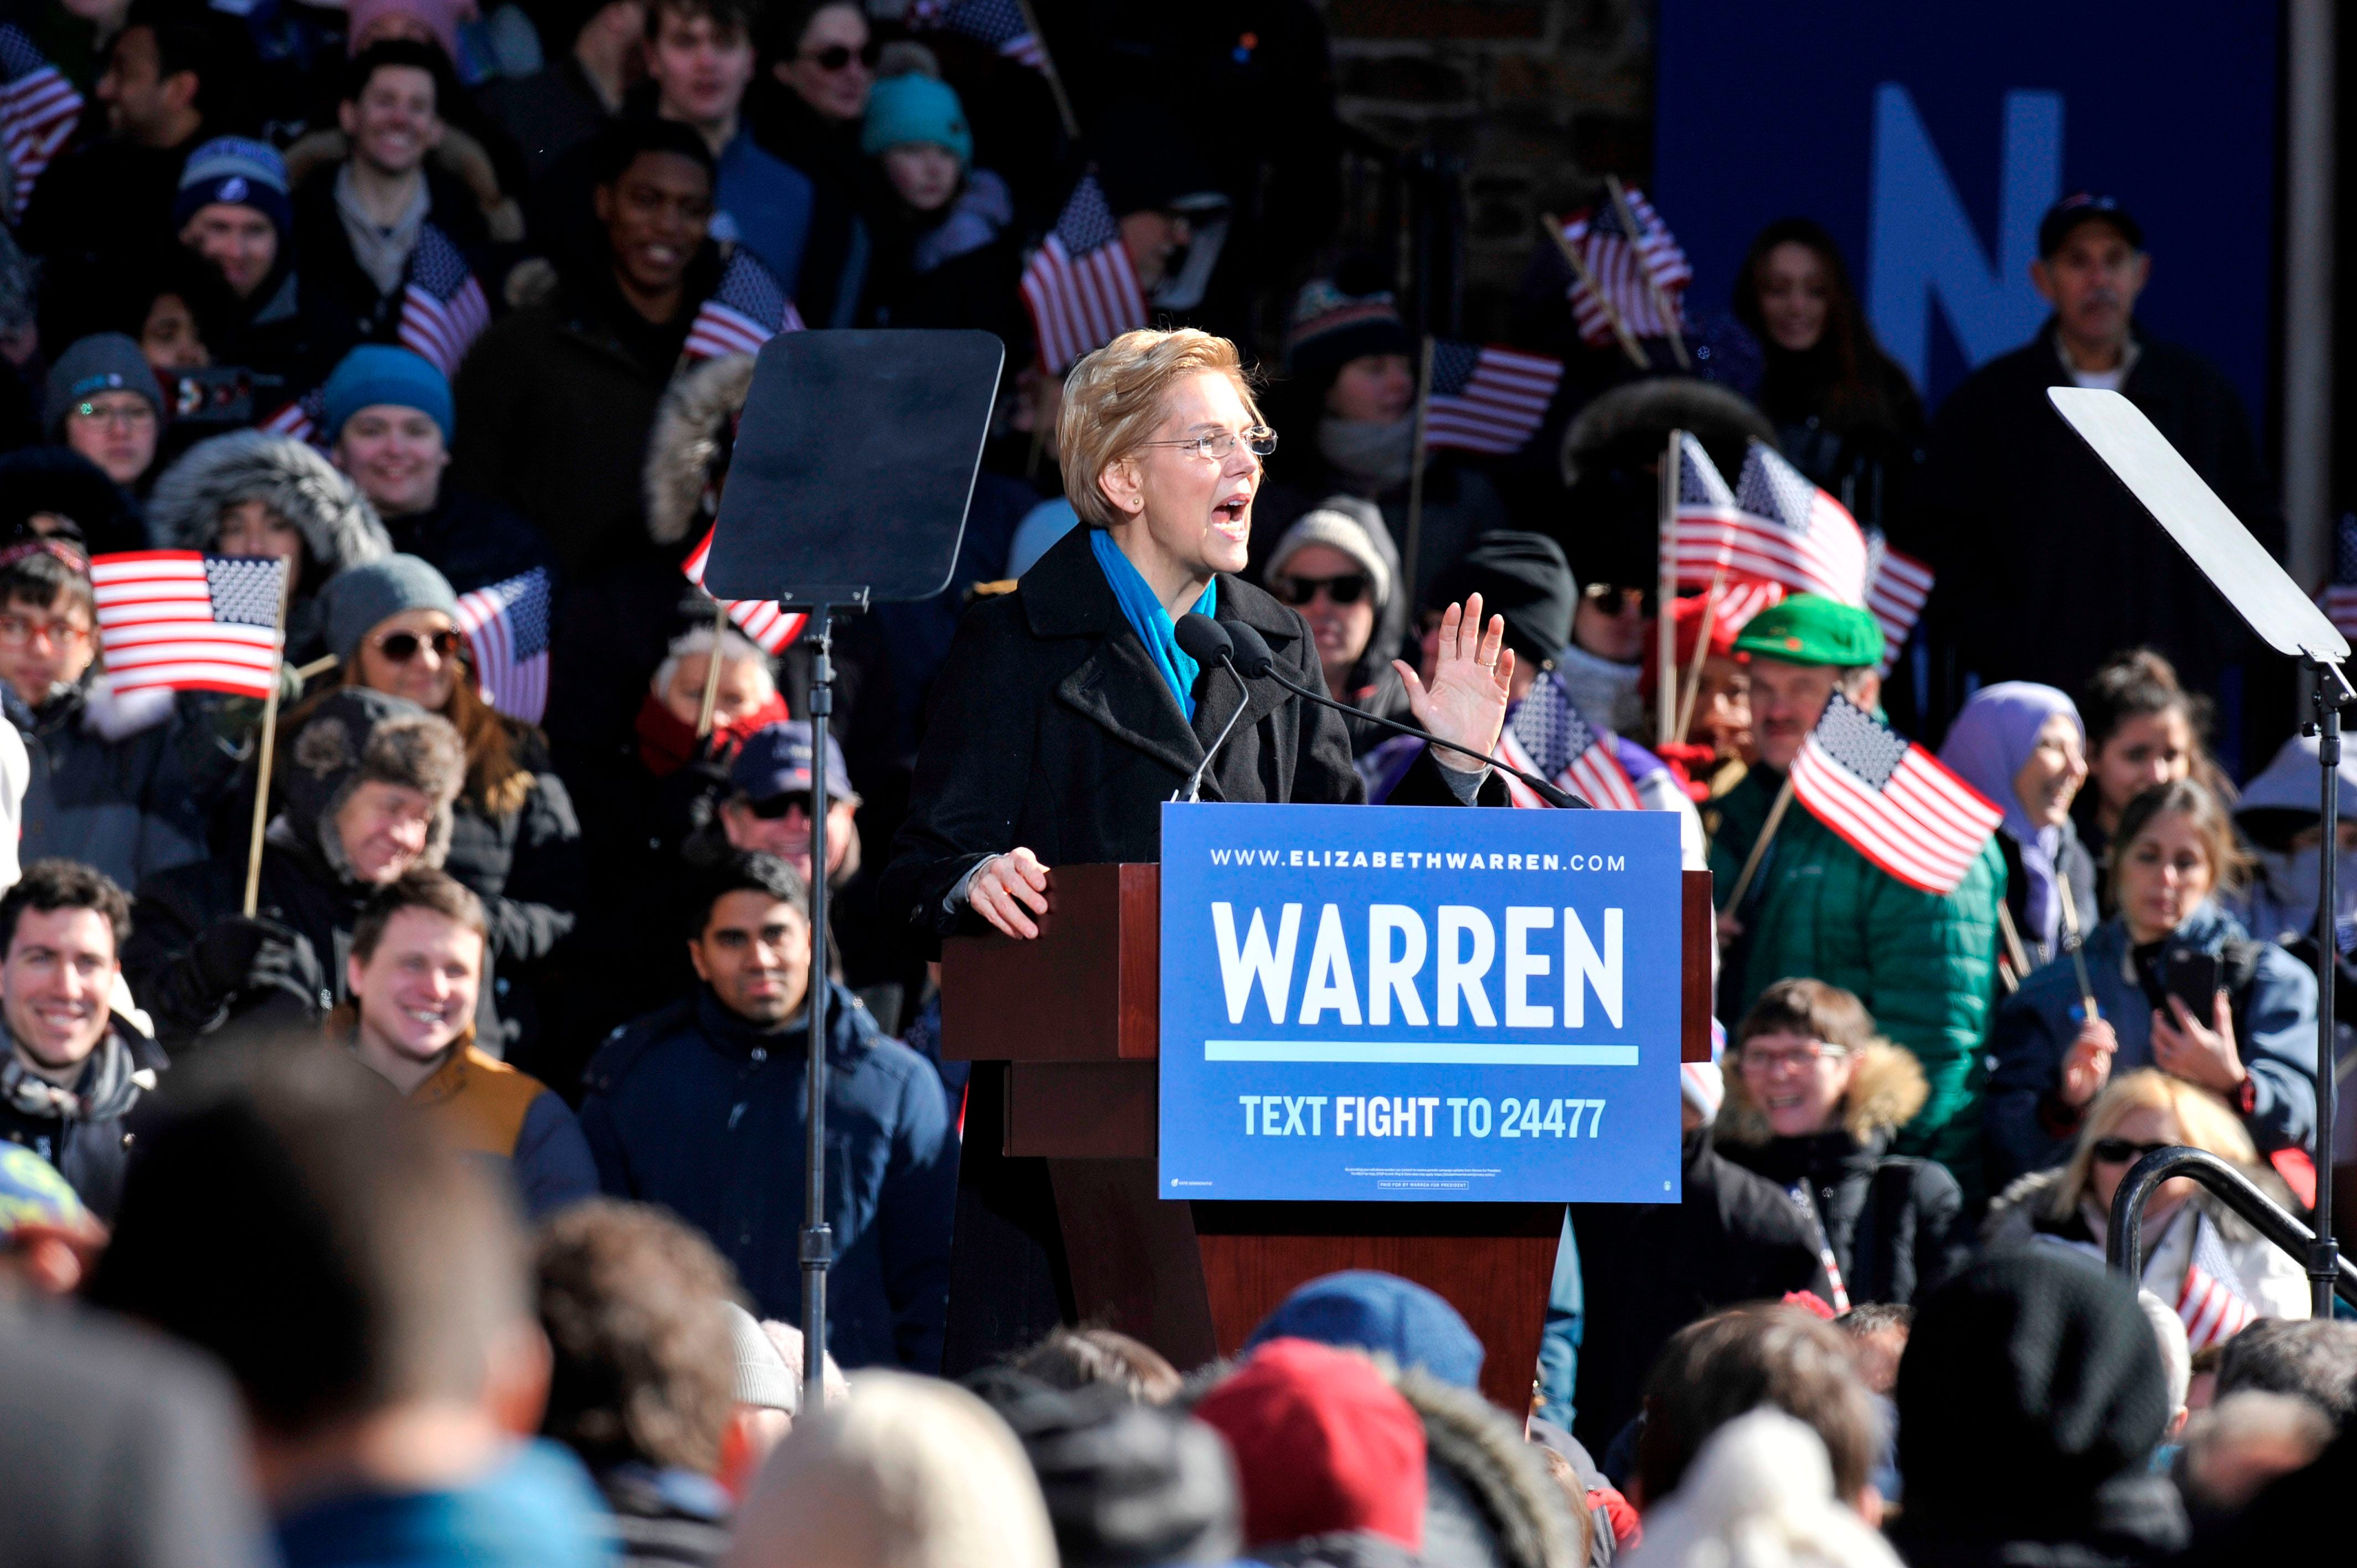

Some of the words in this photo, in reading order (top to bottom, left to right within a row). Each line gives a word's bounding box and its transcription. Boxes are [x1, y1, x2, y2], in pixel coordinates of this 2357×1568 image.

[1867, 83, 2063, 403] N
[1211, 849, 1625, 871] WWW.ELIZABETHWARREN.COM
[1211, 901, 1624, 1029] WARREN
[1239, 1096, 1327, 1136] TEXT
[1336, 1096, 1440, 1137] FIGHT
[1446, 1097, 1491, 1138] TO
[1500, 1098, 1606, 1138] 24477
